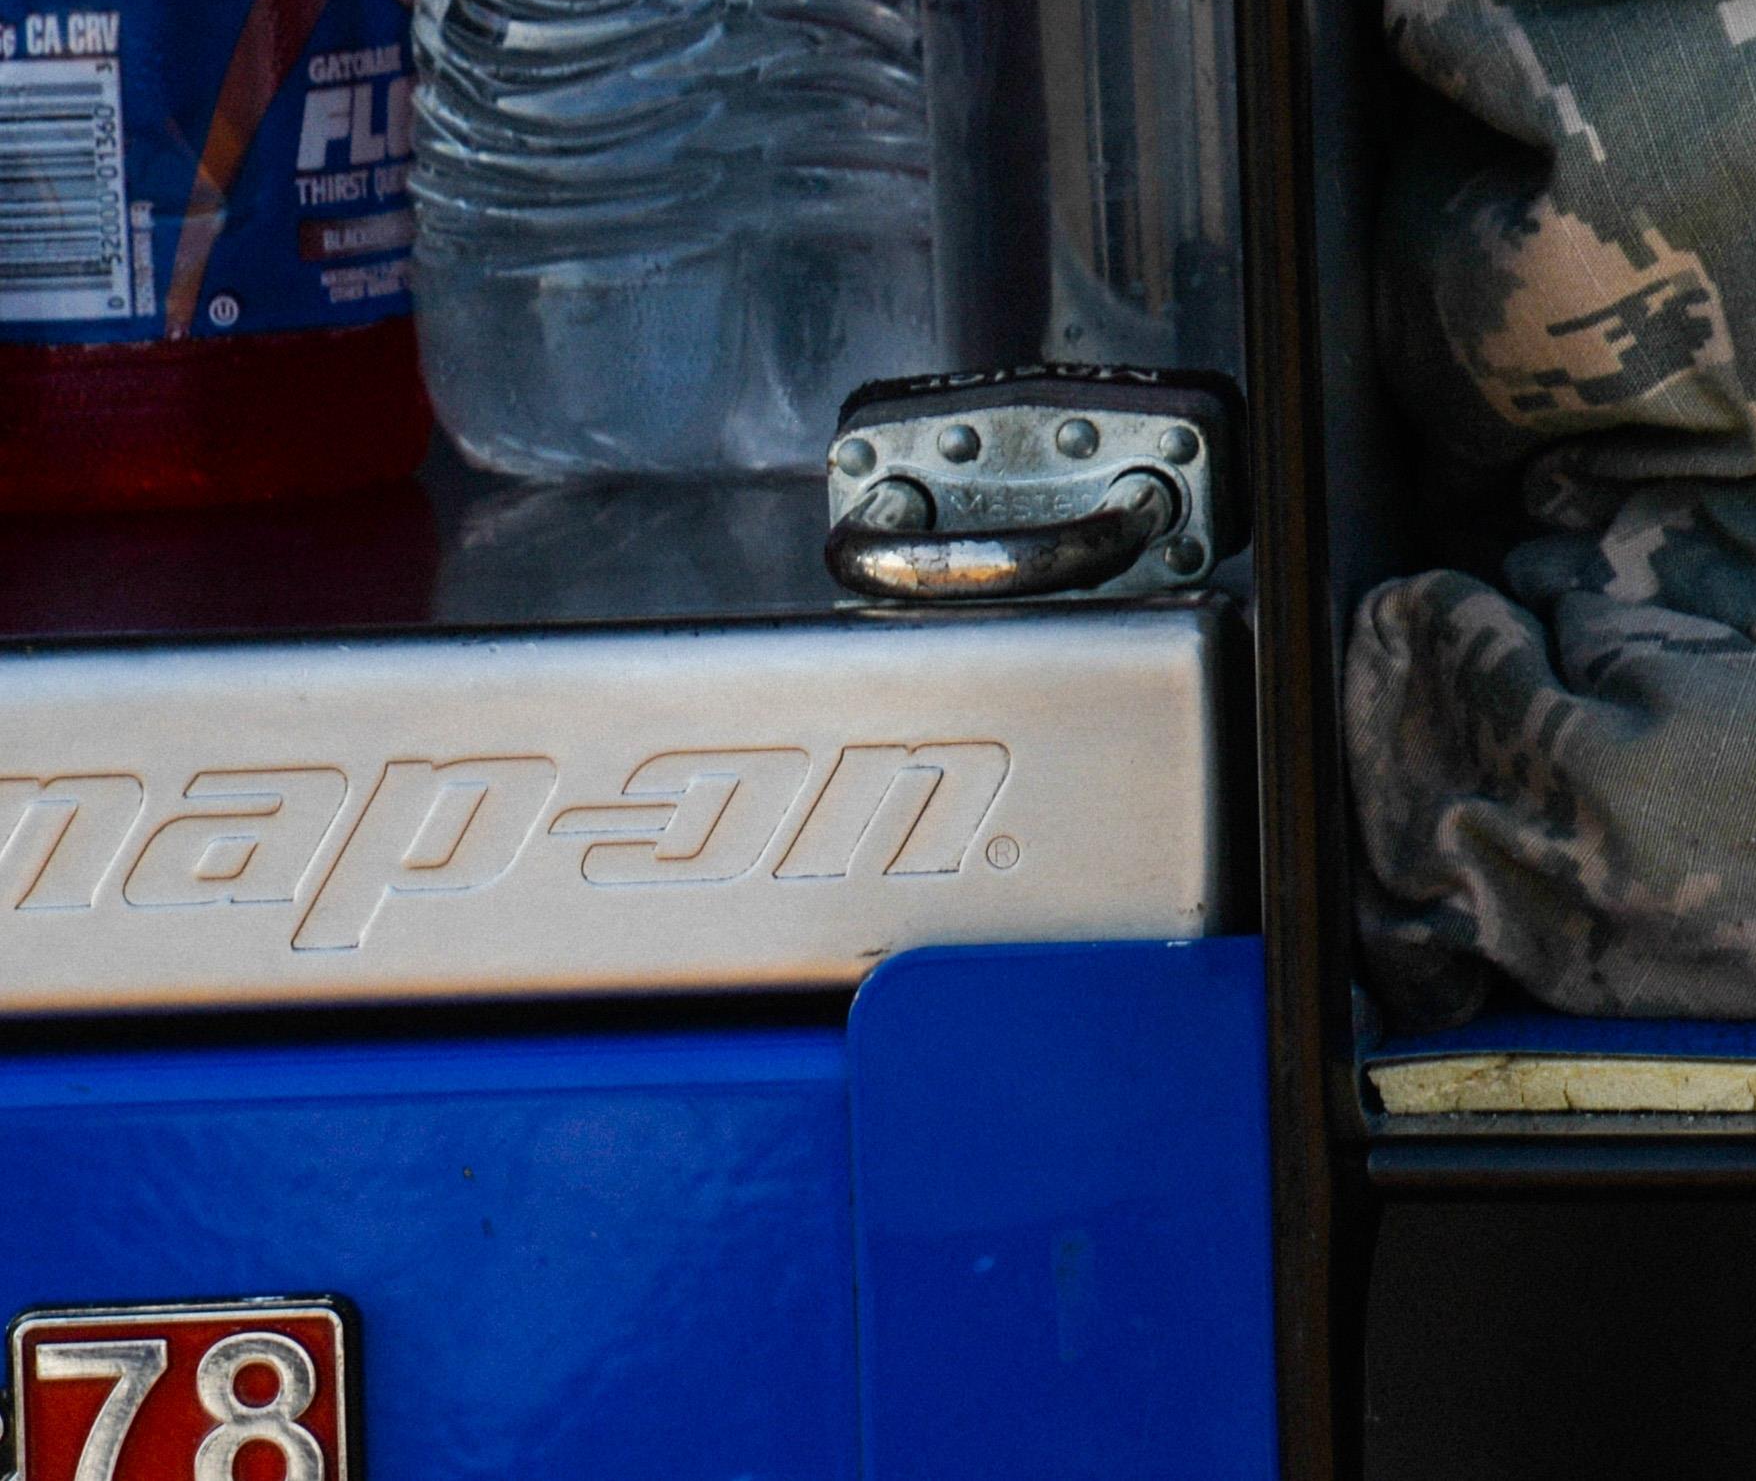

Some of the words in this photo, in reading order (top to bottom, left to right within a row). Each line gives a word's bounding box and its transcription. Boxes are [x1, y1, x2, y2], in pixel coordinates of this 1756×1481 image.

[25, 14, 62, 56] CA
[67, 12, 120, 54] CRV
[295, 170, 369, 206] THIRST
[36, 1331, 325, 1481] 78
